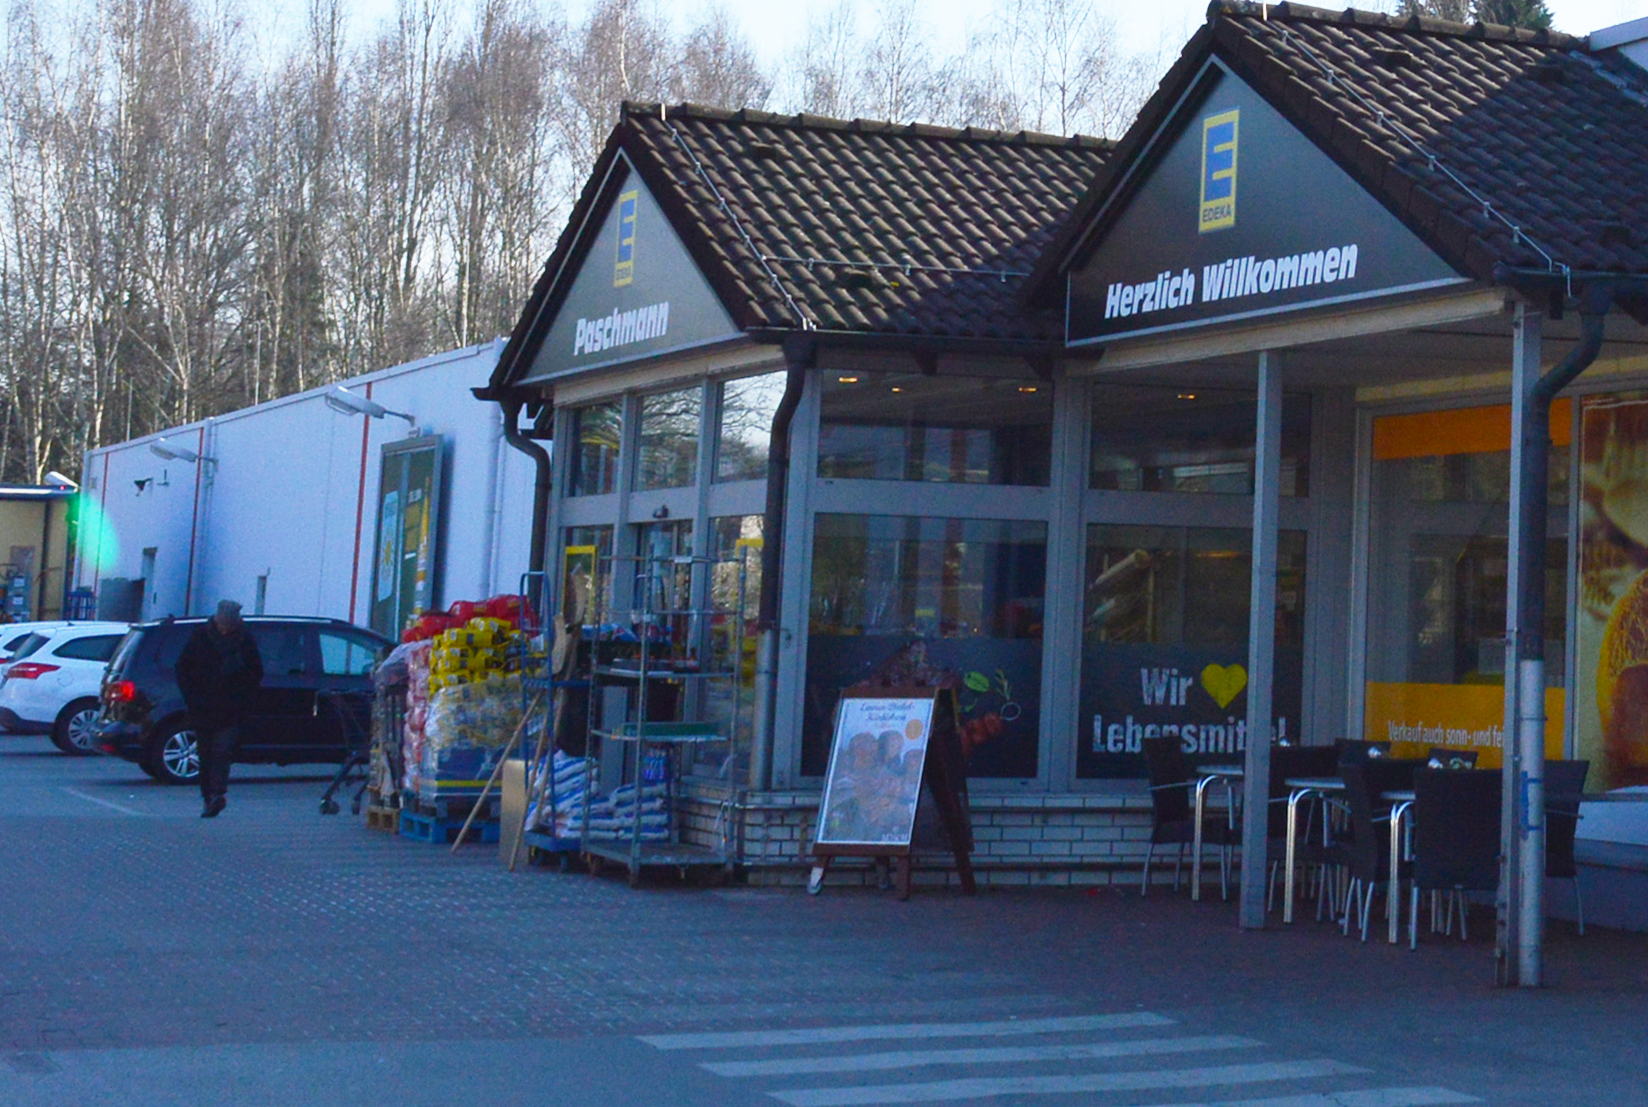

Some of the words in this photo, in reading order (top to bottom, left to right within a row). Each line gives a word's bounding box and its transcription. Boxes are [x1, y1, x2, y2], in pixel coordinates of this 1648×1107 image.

[1202, 203, 1232, 223] EDEKA
[1104, 268, 1196, 319] Herzlich
[1201, 243, 1359, 302] Willkommen
[574, 300, 669, 356] Paschmann
[1140, 667, 1193, 706] Wir
[1092, 714, 1287, 754] Lebesmitl
[1388, 721, 1422, 743] Verkauf
[1422, 722, 1443, 744] auch
[1445, 729, 1471, 745] sonn-
[1473, 724, 1491, 747] und
[1492, 725, 1505, 748] fei
